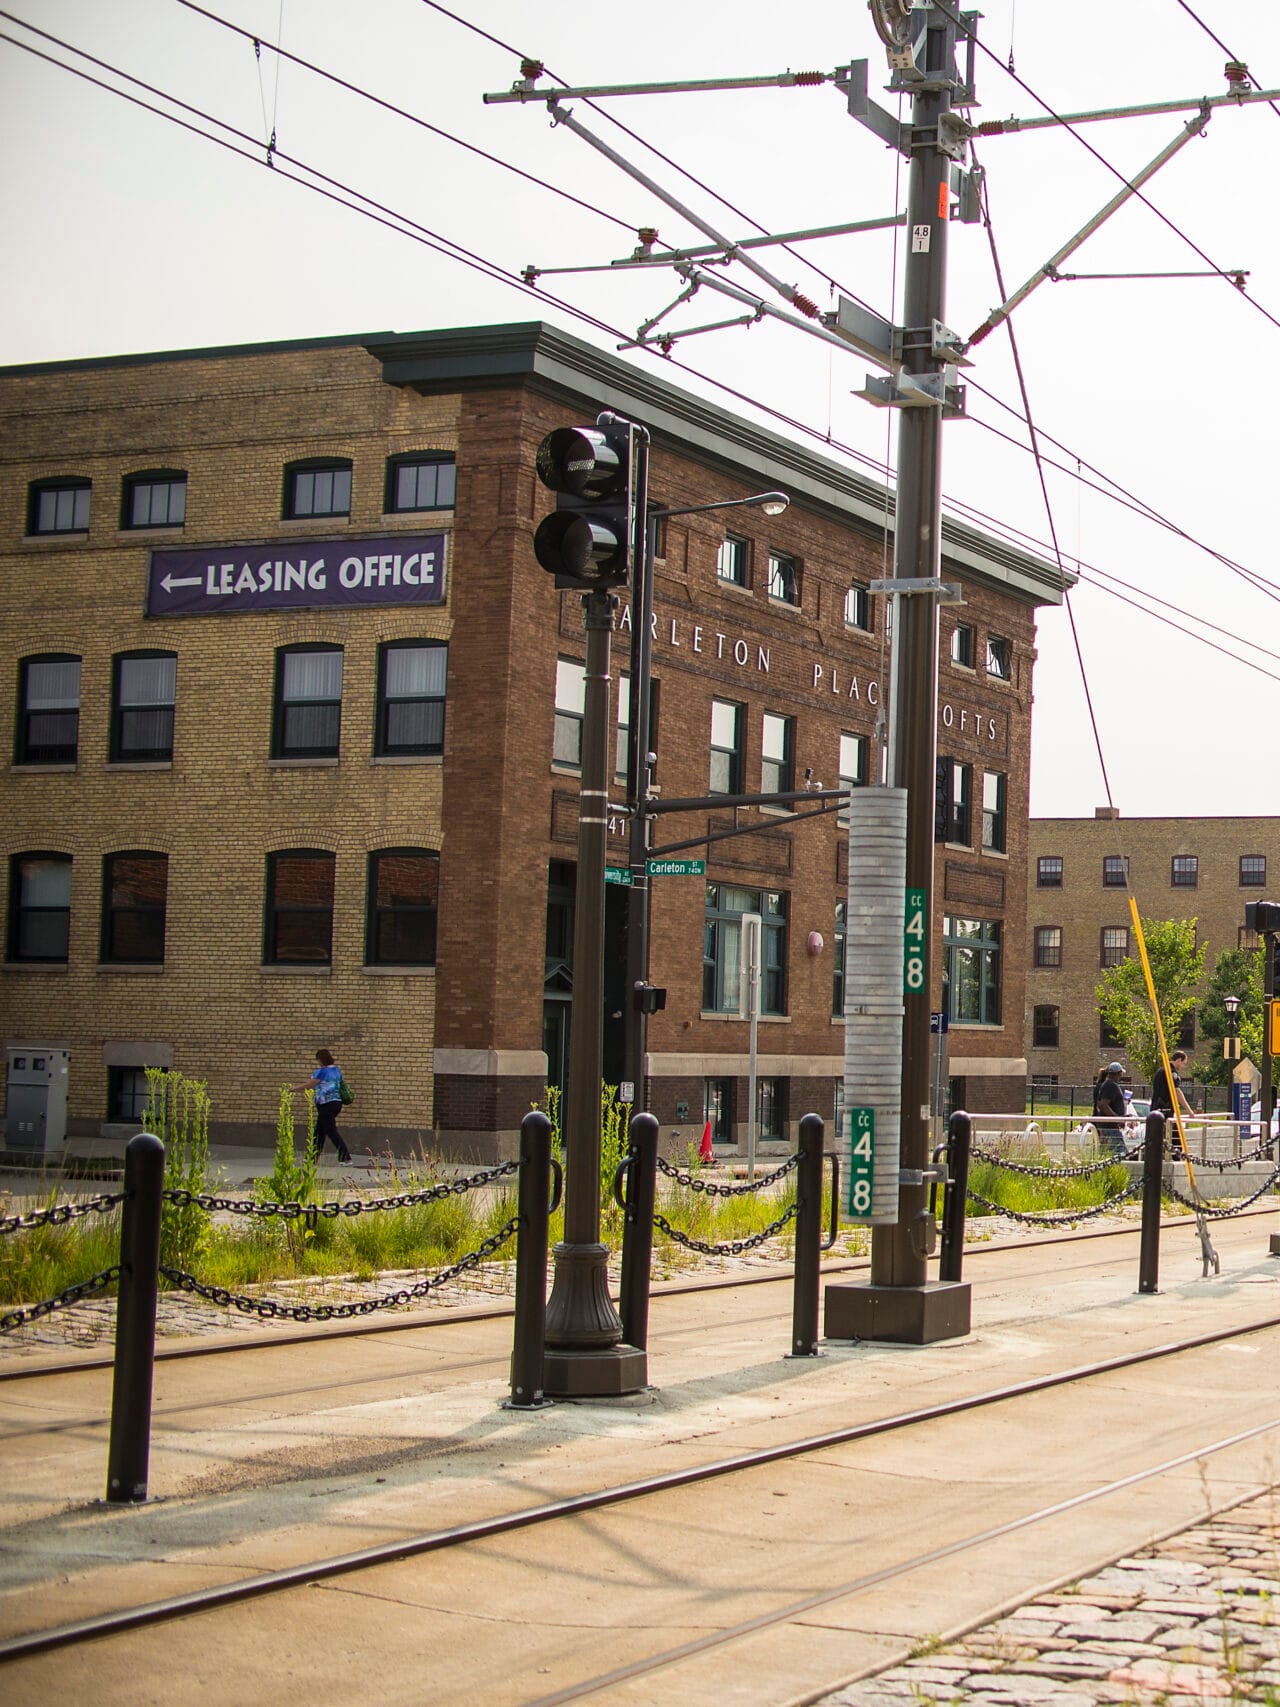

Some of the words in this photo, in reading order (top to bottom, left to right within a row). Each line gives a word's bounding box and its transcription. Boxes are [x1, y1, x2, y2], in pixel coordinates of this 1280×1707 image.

[914, 226, 929, 237] 4.8
[206, 559, 327, 595] LEASING
[338, 551, 435, 589] OFFICE
[619, 604, 771, 673] ARLETON
[813, 663, 879, 705] PLAC
[942, 704, 997, 741] OFTS
[650, 862, 686, 874] Carleton
[911, 895, 922, 906] CC
[858, 1114, 870, 1127] CC
